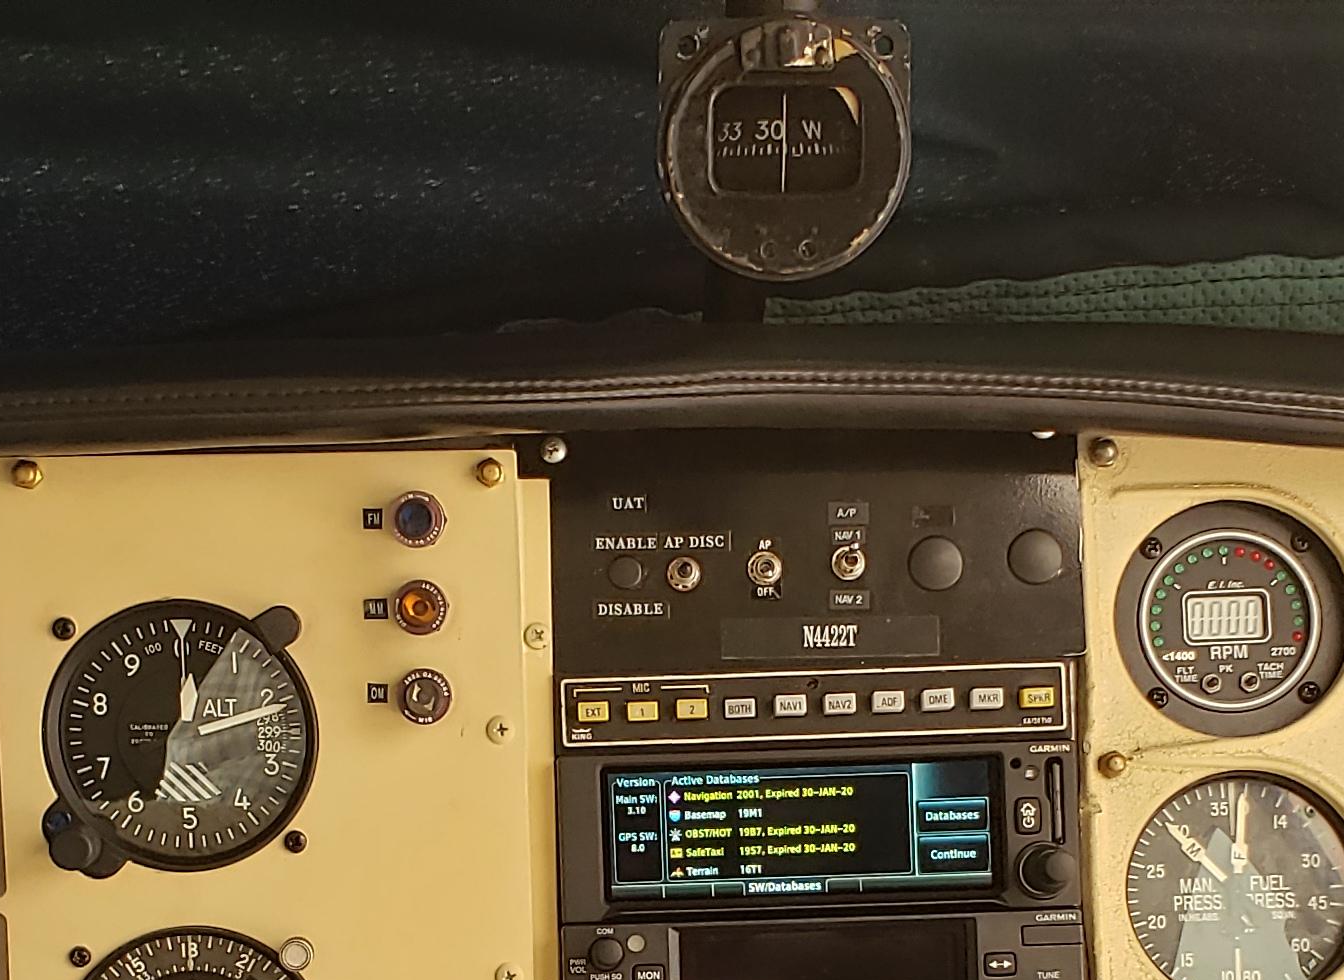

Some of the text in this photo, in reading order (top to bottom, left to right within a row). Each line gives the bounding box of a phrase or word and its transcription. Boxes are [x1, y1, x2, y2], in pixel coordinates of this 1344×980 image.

[718, 121, 821, 141] 33 30 W
[613, 497, 644, 510] UAT
[367, 513, 380, 525] FM
[836, 508, 857, 518] A/P
[664, 535, 724, 549] AP DISC
[835, 531, 861, 541] NAV 1
[596, 537, 656, 550] ENABLE
[835, 595, 862, 605] NAV 2
[598, 603, 663, 617] DISABLE
[803, 625, 858, 648] N4422T
[1210, 645, 1248, 660] RPM
[124, 654, 140, 676] 9
[632, 683, 651, 694] MIC
[93, 694, 107, 715] 8
[828, 699, 852, 711] NAV2
[880, 696, 899, 708] ADF
[928, 693, 949, 705] DME
[978, 692, 999, 704] MKR
[1027, 693, 1051, 704] SPKR
[203, 698, 237, 718] ALT
[728, 703, 751, 715] BOTH
[779, 700, 803, 713] NAV1
[1030, 743, 1071, 753] GARMIN
[96, 757, 110, 779] 7
[616, 776, 656, 788] Version
[670, 773, 760, 787] Active Databases
[234, 789, 251, 810] 4
[684, 786, 853, 803] Navigation 2001, Expired 30-JAN-20
[128, 791, 144, 813] 6
[183, 807, 198, 829] 5
[684, 807, 763, 822] Basemap 19M1
[925, 808, 980, 822] Databases
[686, 846, 725, 858] SafeTaxi
[768, 843, 801, 856] Expired
[804, 841, 856, 854] 30-JAN-20
[930, 847, 977, 860] Continue
[748, 879, 822, 893] SW/Databases
[1179, 879, 1216, 894] MAN.
[1250, 875, 1290, 890] FUEL
[1174, 895, 1226, 911] PRESS.
[1035, 913, 1076, 922] GARMIN
[1037, 971, 1060, 980] TUNE
